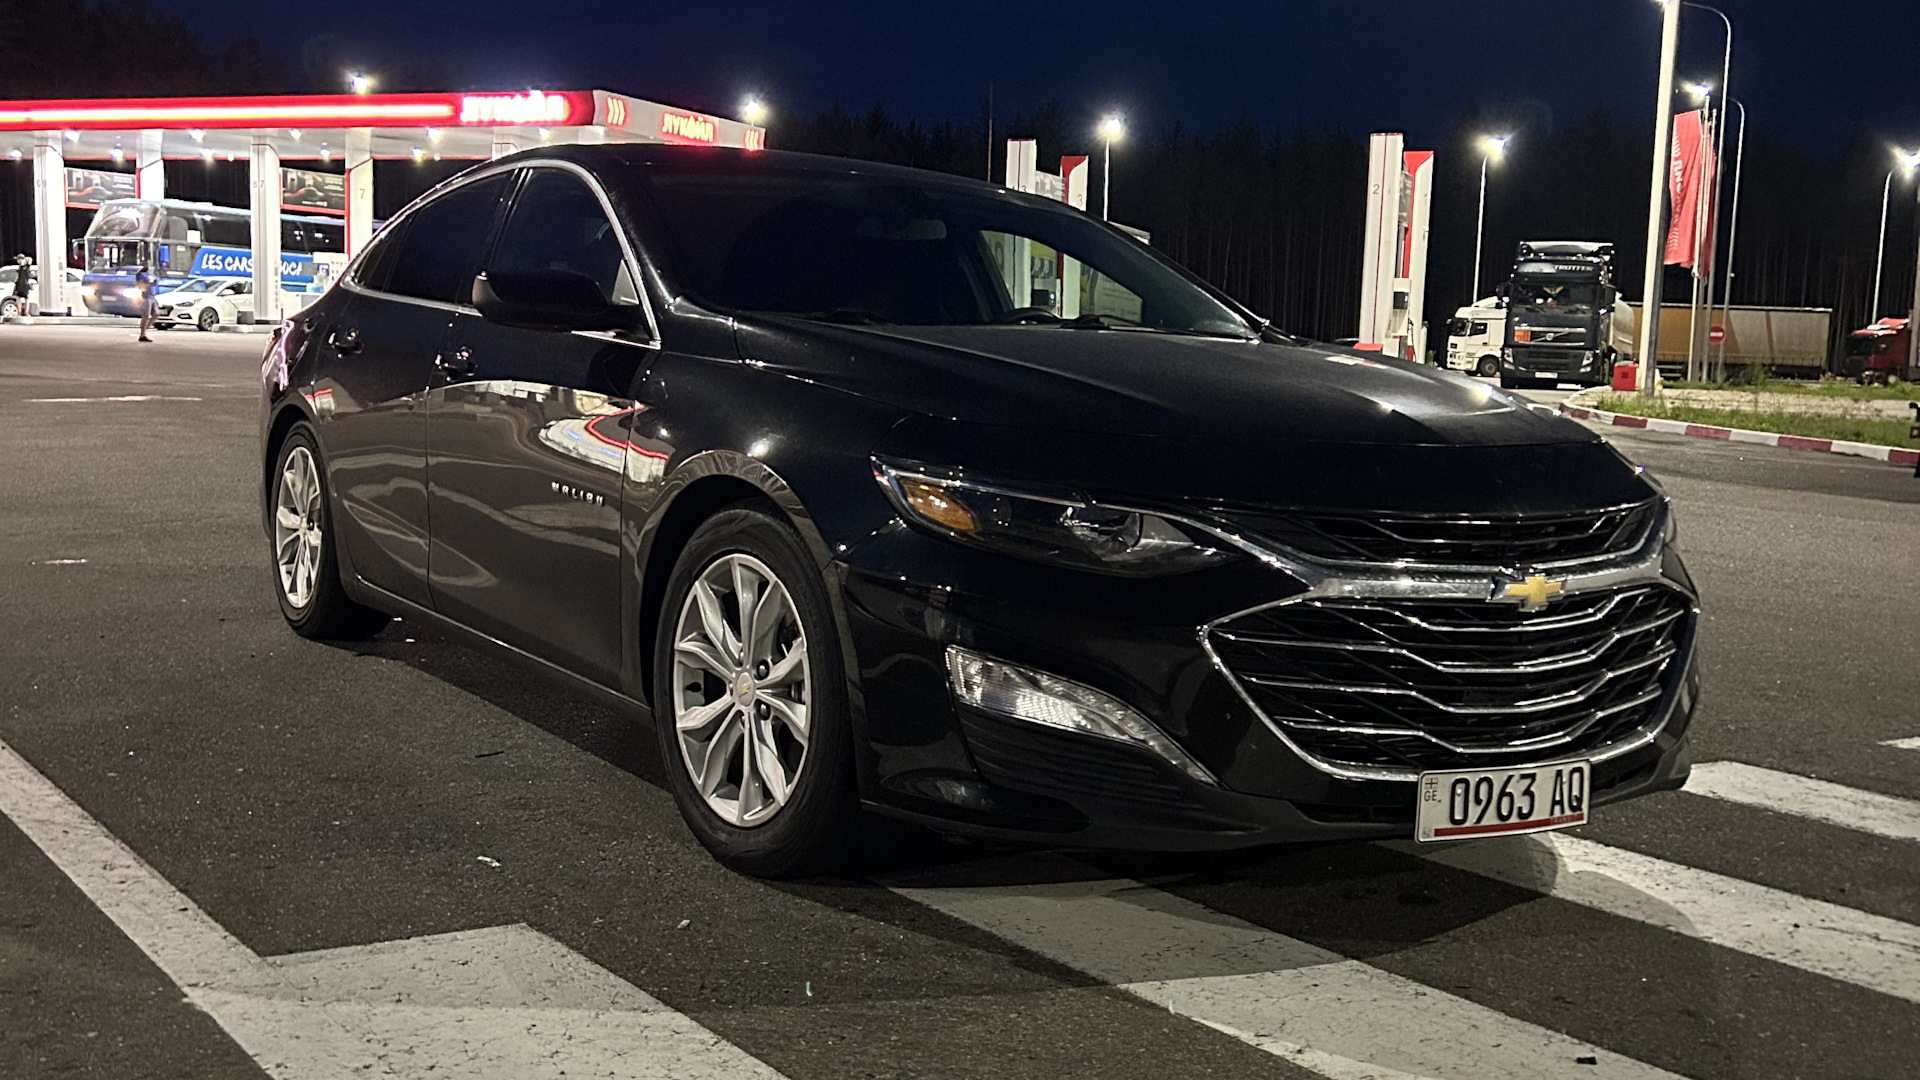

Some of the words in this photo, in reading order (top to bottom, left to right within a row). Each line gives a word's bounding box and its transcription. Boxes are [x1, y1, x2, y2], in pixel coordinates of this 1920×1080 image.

[359, 188, 366, 199] 7
[1373, 184, 1380, 194] 2
[1077, 193, 1083, 207] 3
[201, 253, 222, 269] LES
[224, 256, 253, 273] CARS
[551, 481, 604, 507] MALIBU
[1424, 789, 1438, 802] GE
[1450, 772, 1537, 826] 0963
[1550, 766, 1584, 817] AQ
